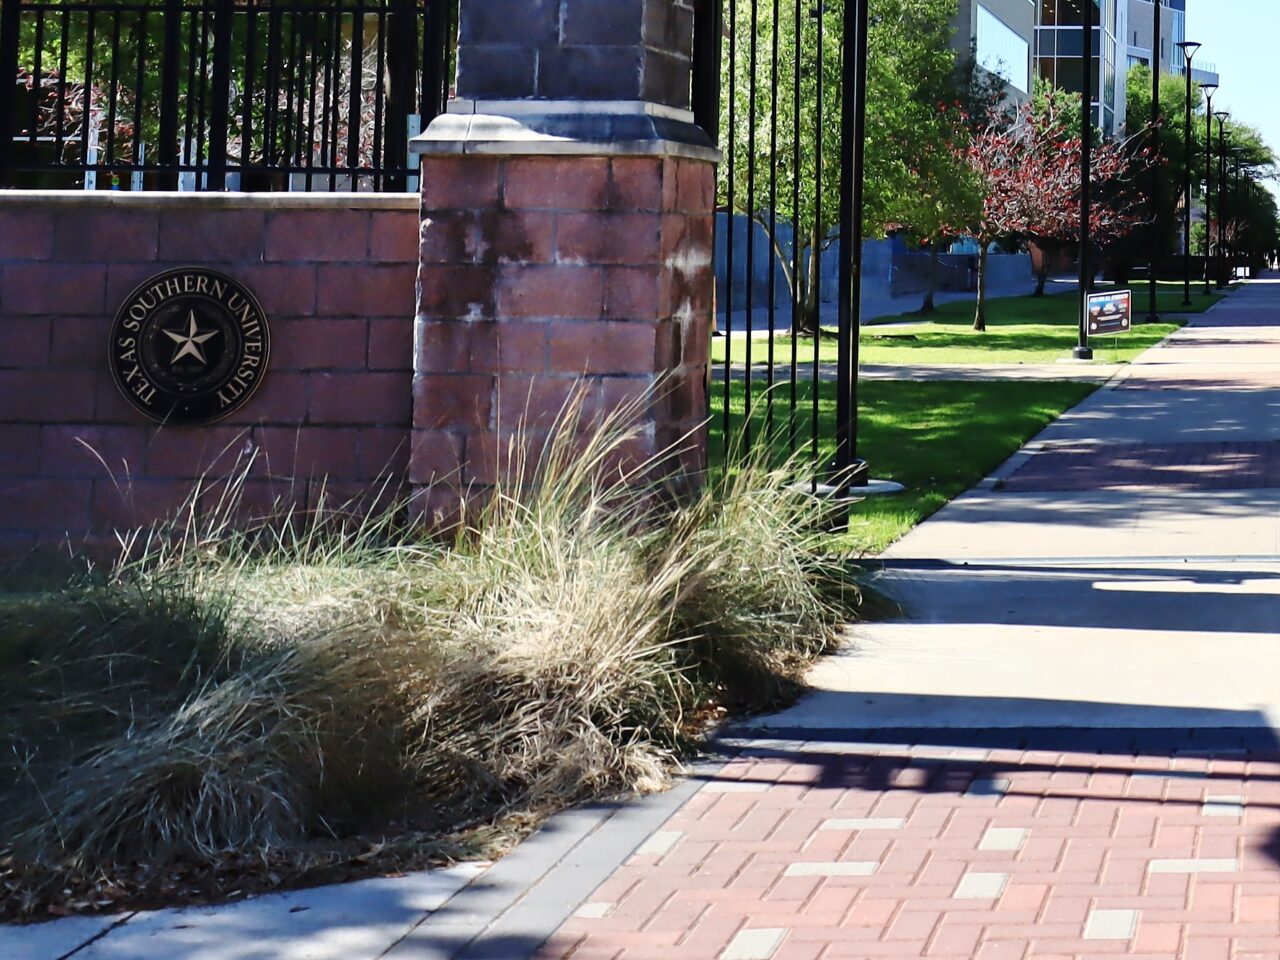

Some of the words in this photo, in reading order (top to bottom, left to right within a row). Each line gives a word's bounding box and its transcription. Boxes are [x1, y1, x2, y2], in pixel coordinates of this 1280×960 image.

[123, 275, 228, 332] SOUTHERN
[119, 337, 156, 405] TEXAS
[216, 293, 263, 408] UNIVERSITY
